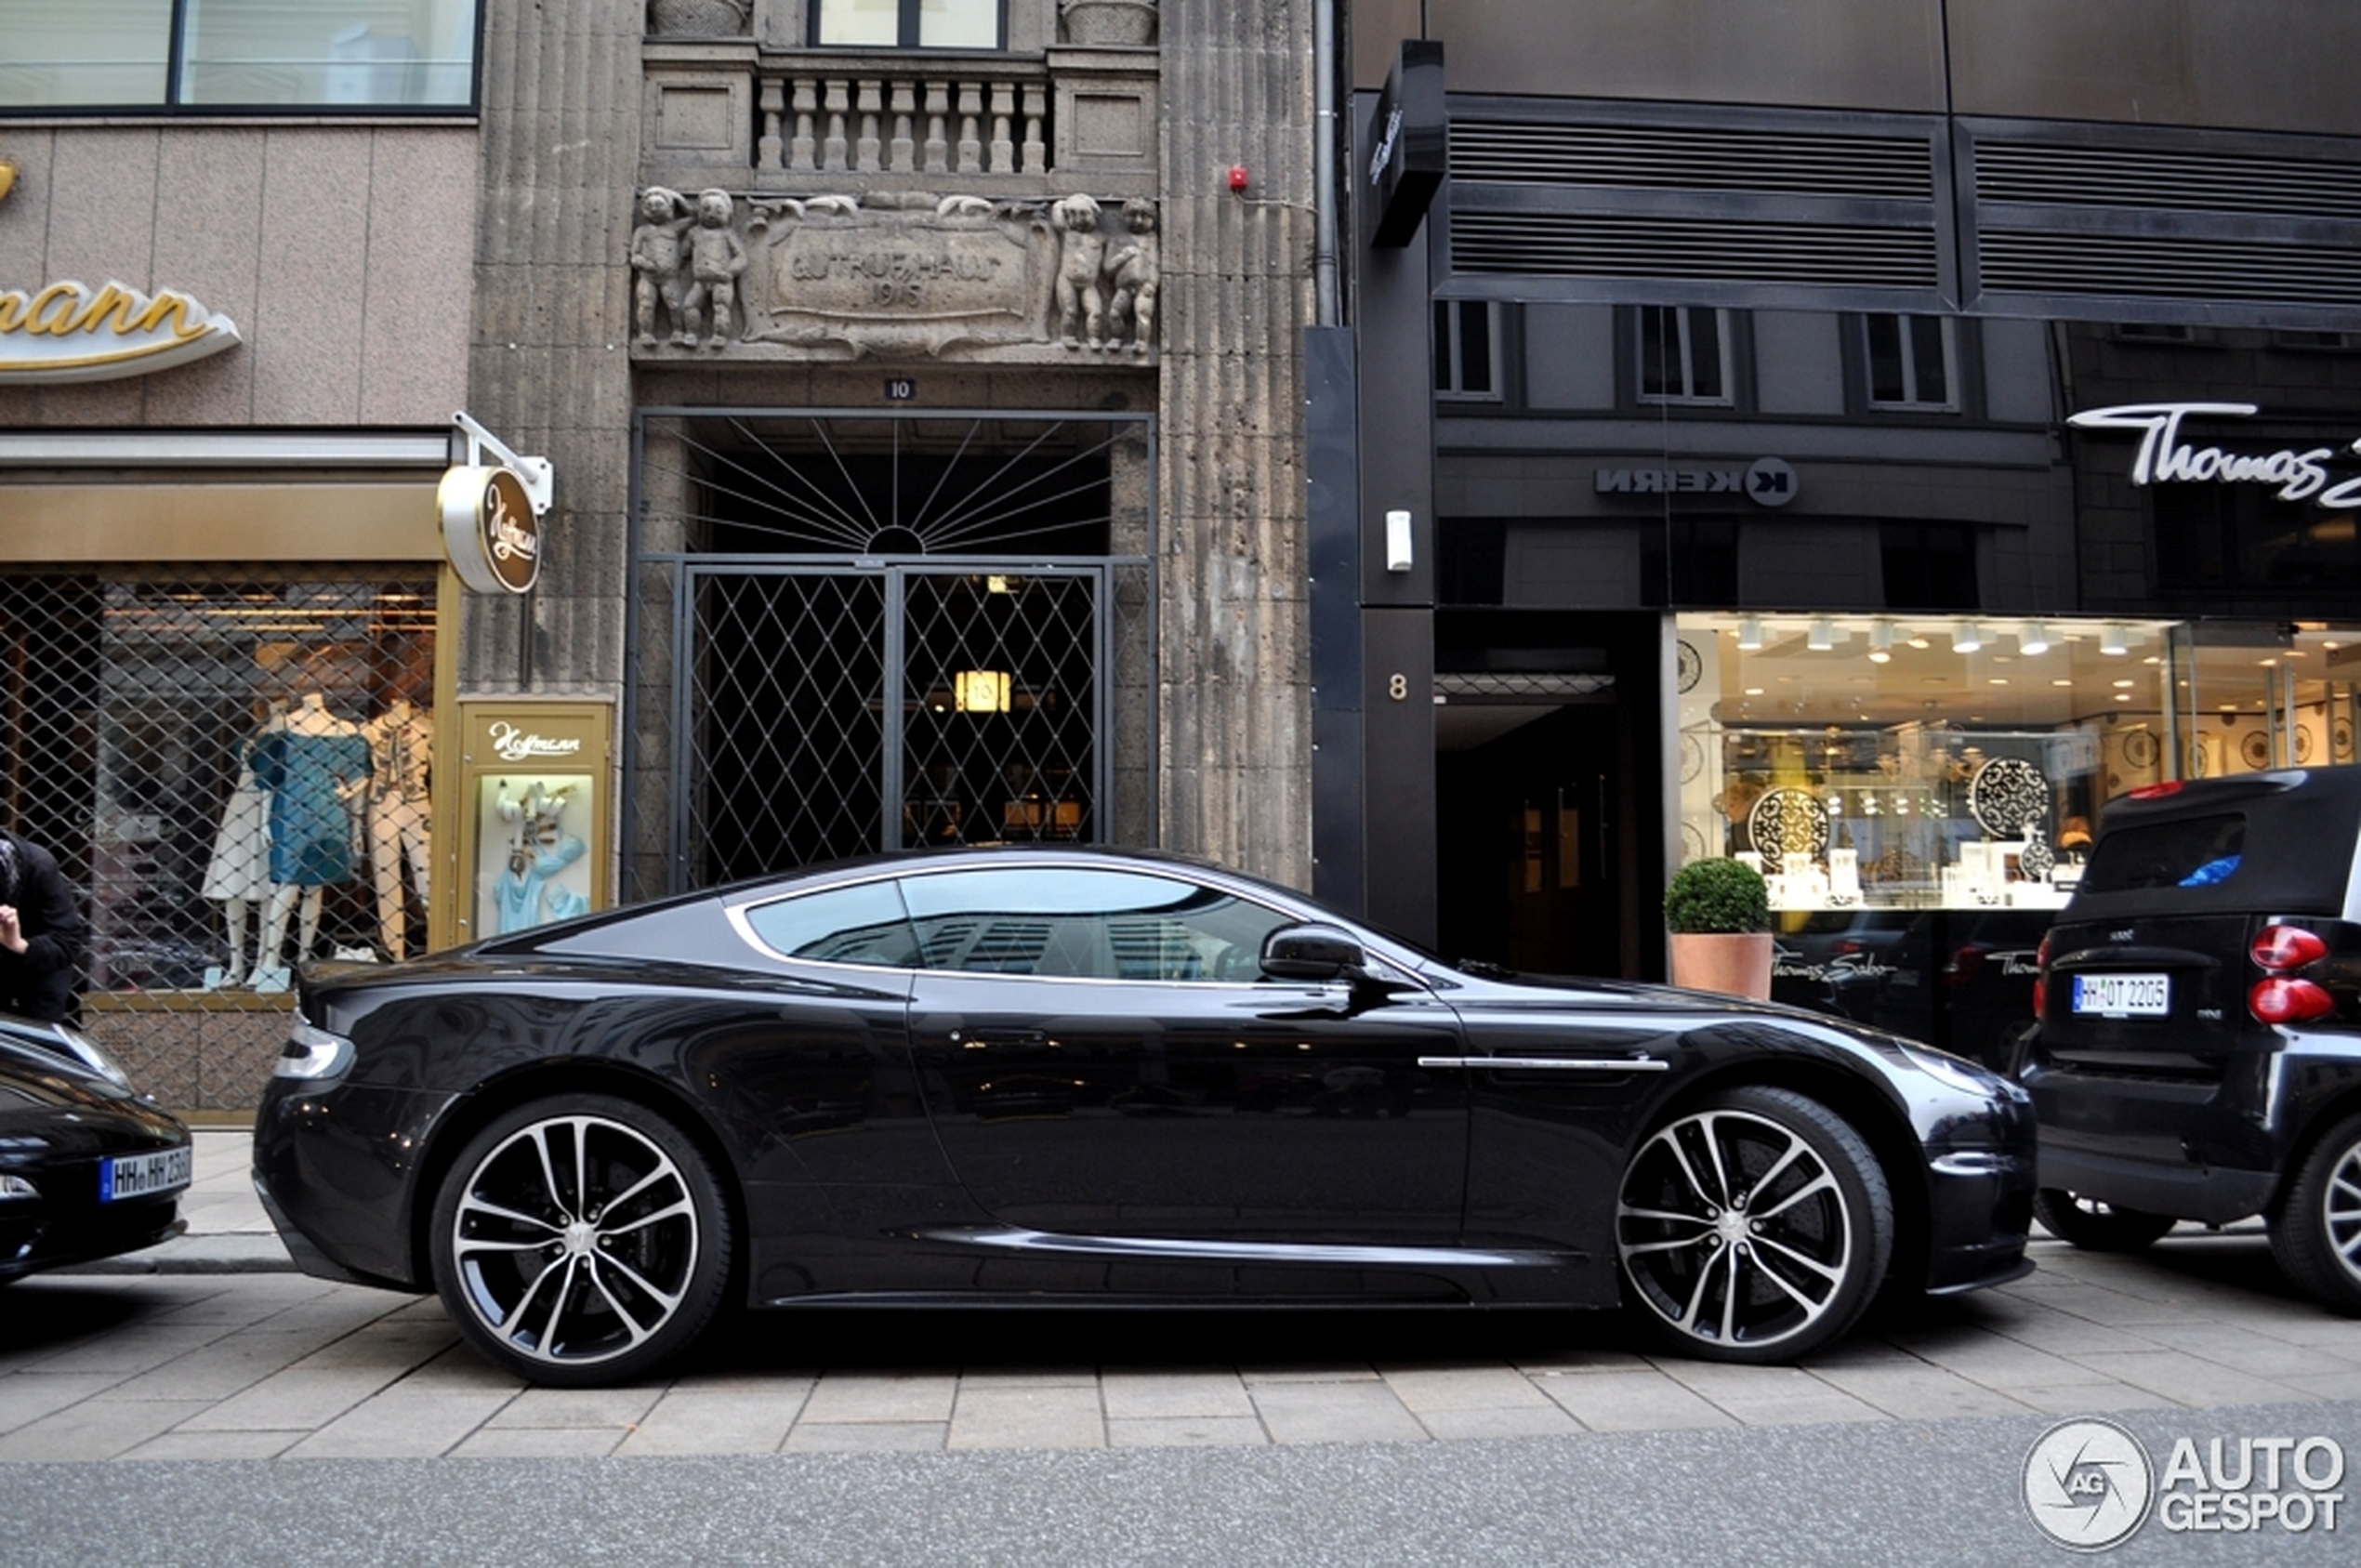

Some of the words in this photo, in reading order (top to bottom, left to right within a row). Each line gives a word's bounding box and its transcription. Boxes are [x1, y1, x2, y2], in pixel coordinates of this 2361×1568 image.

[891, 382, 909, 398] 10
[2065, 402, 2332, 501] Thomas
[1390, 674, 1407, 700] 8
[1985, 950, 2043, 976] Thom
[2128, 980, 2165, 1008] 2205
